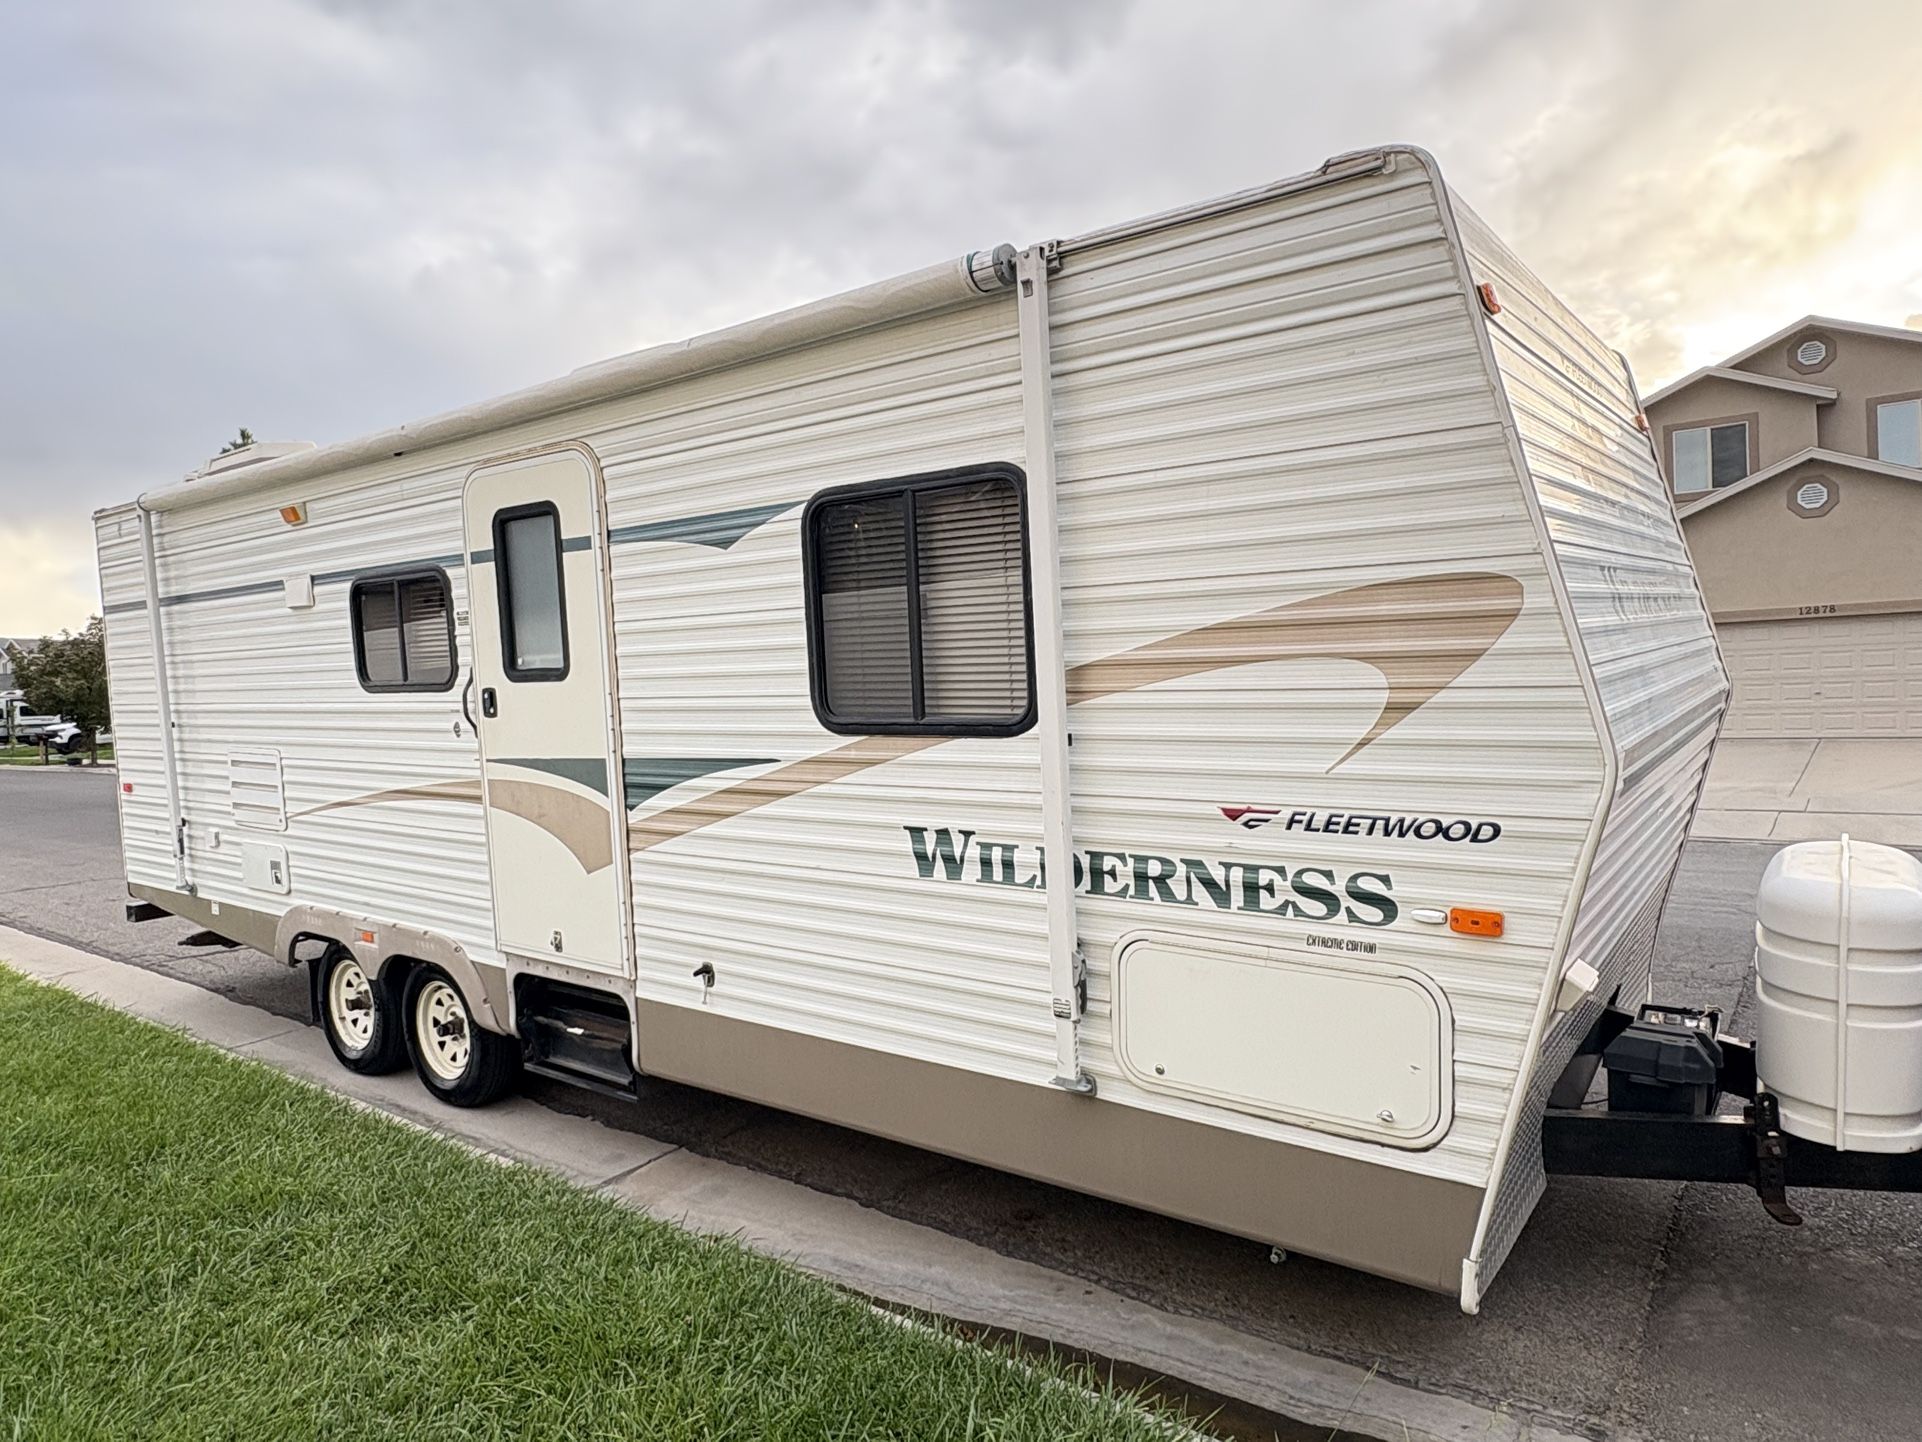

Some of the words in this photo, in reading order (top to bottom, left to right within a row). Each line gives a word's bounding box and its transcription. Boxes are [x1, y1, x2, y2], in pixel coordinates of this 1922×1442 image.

[1798, 604, 1837, 616] 12878
[1285, 811, 1502, 844] FLEETWOOD
[1345, 940, 1377, 954] EDITION
